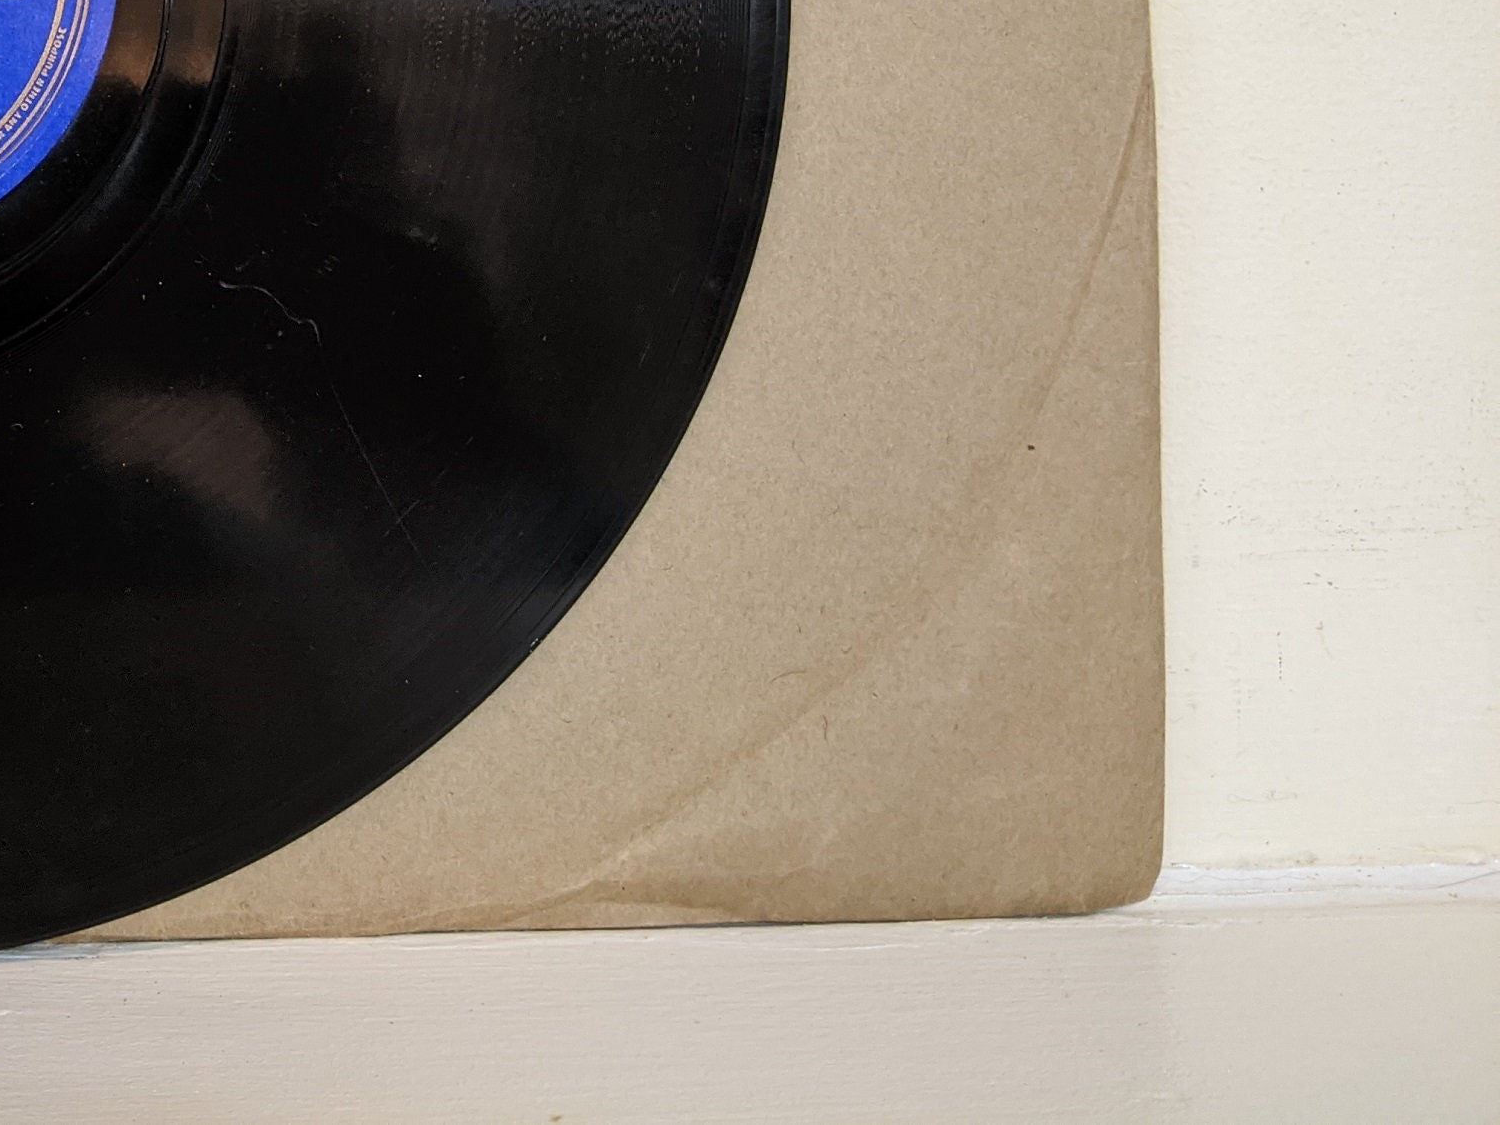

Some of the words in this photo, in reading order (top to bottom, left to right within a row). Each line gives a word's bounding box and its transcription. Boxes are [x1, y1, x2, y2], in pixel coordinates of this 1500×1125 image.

[4, 112, 22, 131] ANY
[20, 78, 45, 112] OTHER
[41, 27, 67, 77] PURPOSE
